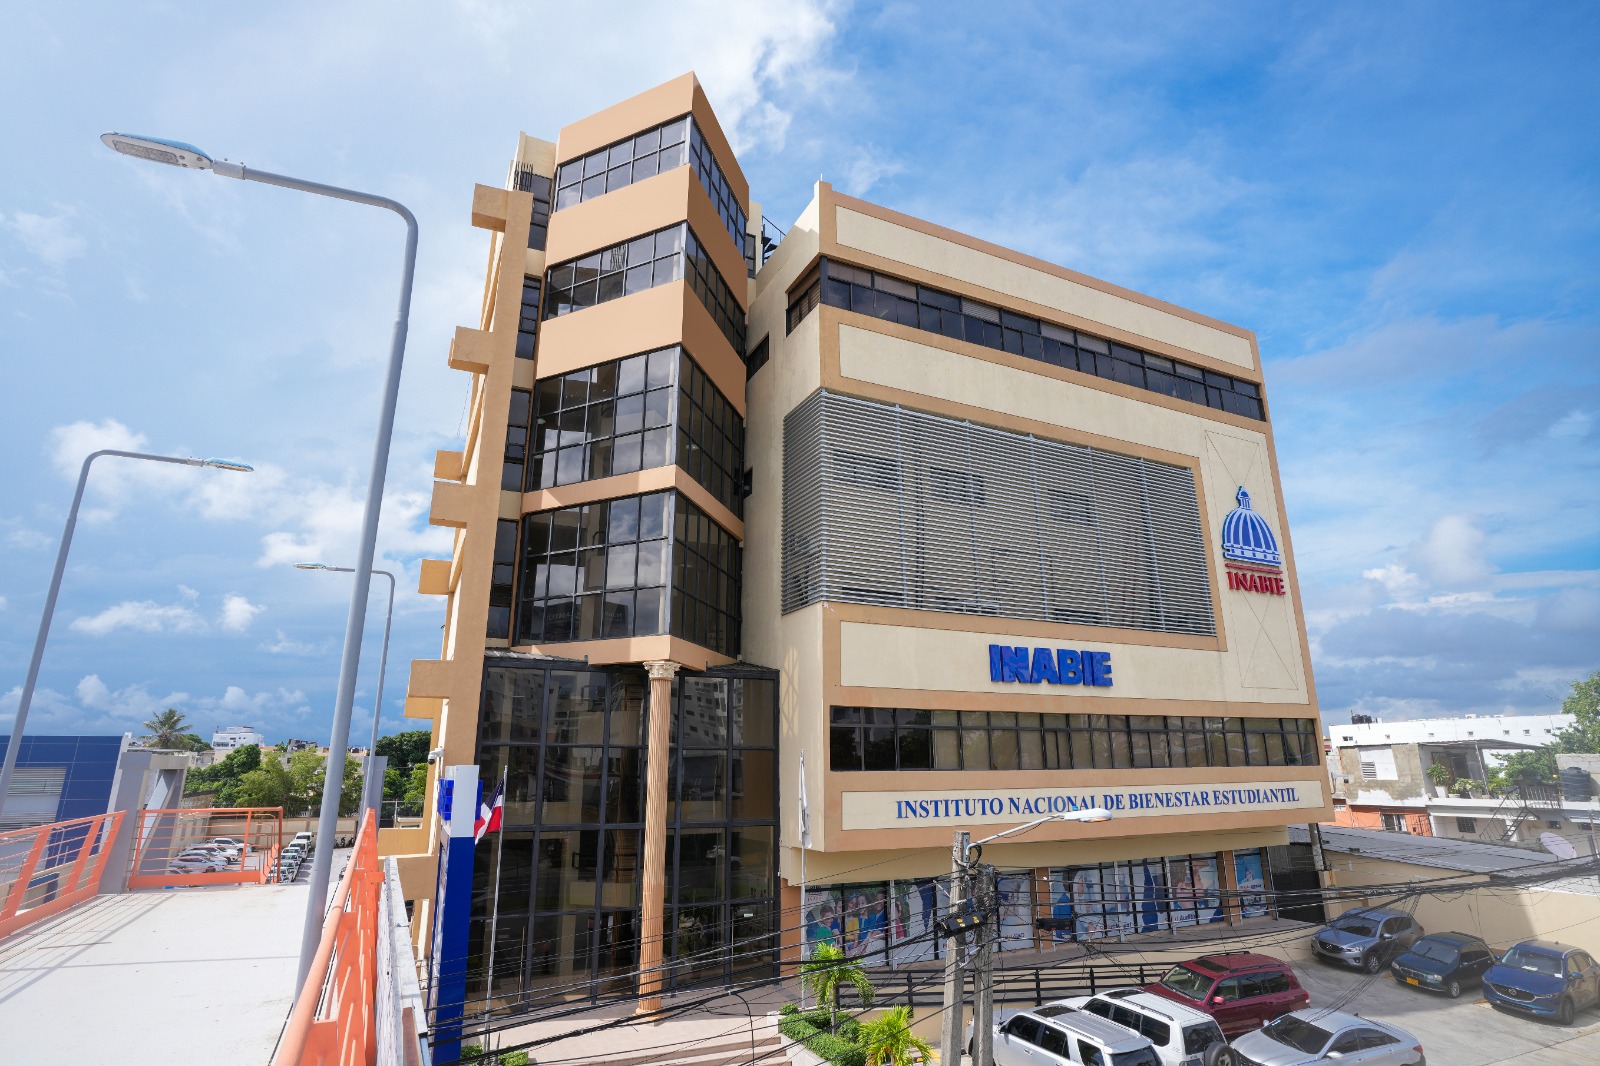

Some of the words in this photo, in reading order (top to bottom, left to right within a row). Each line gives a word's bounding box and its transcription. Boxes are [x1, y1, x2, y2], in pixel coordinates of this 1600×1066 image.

[1226, 571, 1286, 596] INABIE
[989, 644, 1113, 687] INABIE
[896, 798, 1003, 819] INSTITUTO
[1008, 795, 1100, 814] NACIONAL
[1103, 794, 1125, 811] DE
[1128, 790, 1211, 809] BIENESTAR
[1213, 787, 1300, 807] ESTUDIANTIL
